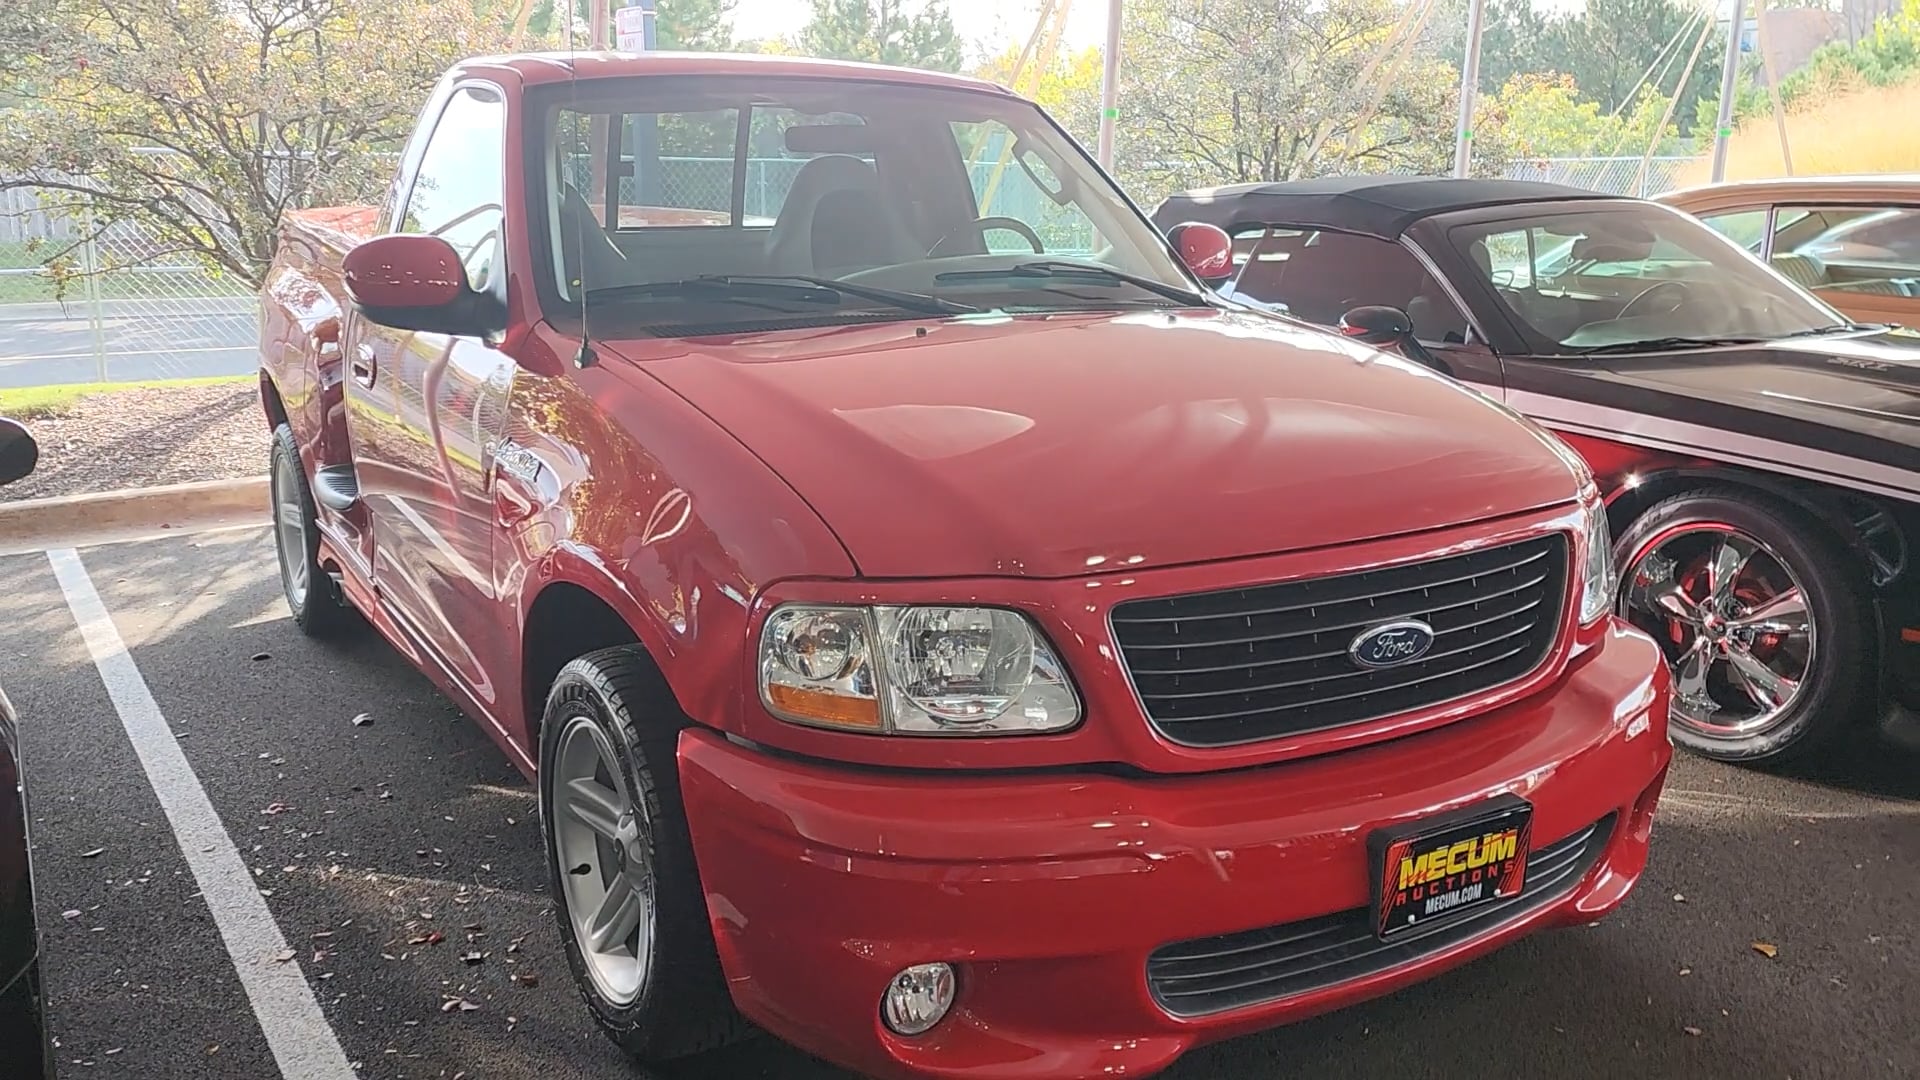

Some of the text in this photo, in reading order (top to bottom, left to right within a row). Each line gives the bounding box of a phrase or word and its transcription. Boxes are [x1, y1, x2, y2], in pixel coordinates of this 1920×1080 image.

[1372, 630, 1418, 659] Ford
[1398, 830, 1517, 890] MECUM
[1396, 861, 1516, 907] AUCTIONS
[1425, 883, 1483, 915] MECUM.COM
